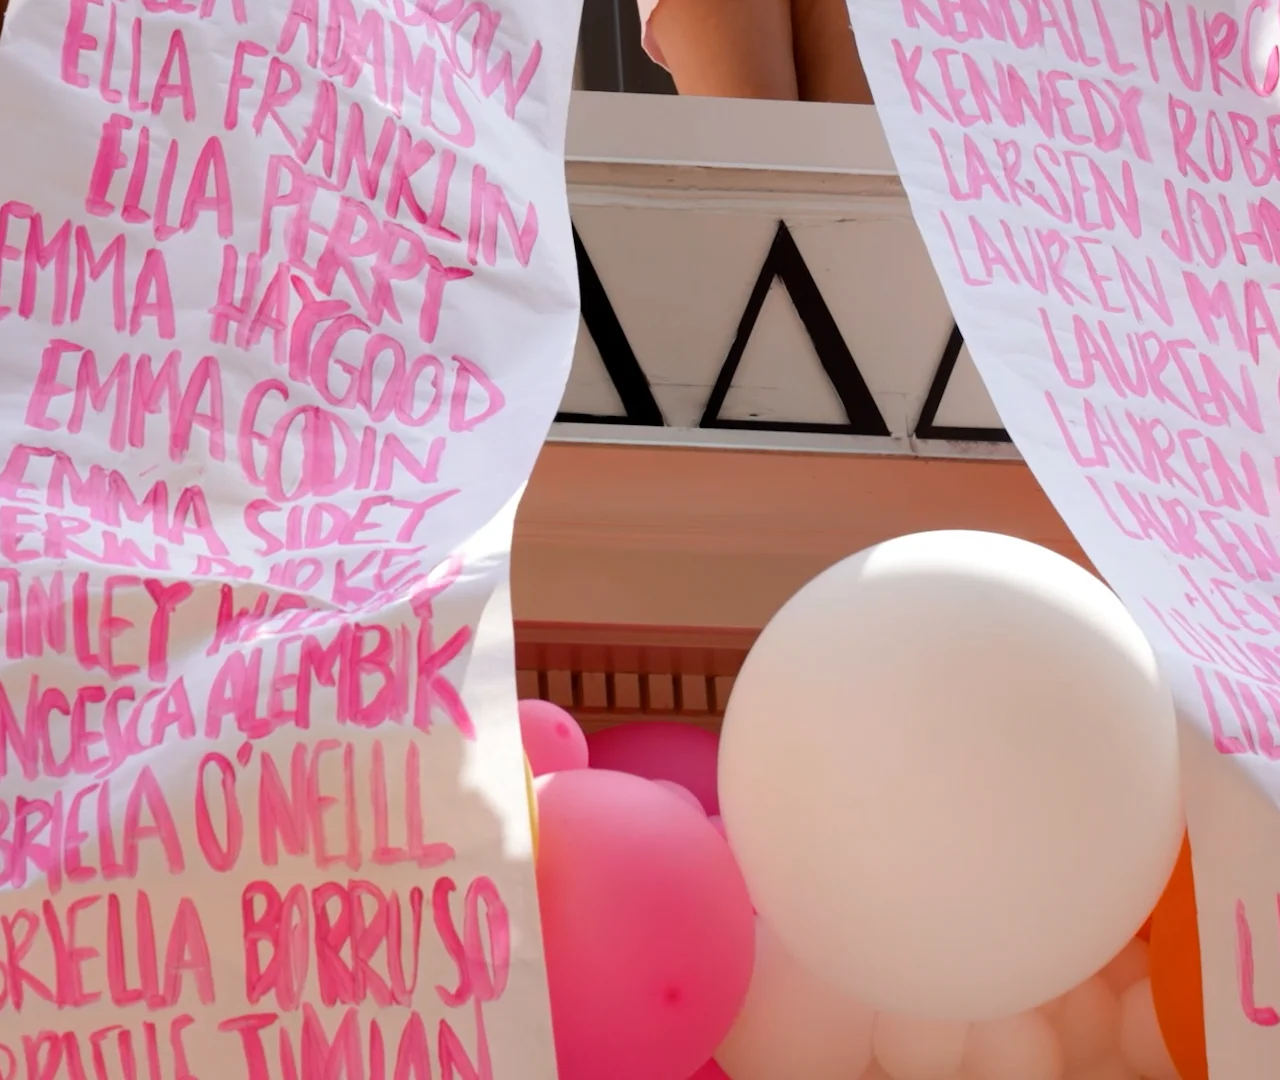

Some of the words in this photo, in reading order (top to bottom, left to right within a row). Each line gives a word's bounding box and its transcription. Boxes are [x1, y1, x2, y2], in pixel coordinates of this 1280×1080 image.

[223, 40, 539, 268] FRANKLIN
[890, 37, 1154, 163] KENNEDY
[85, 114, 234, 243] ELLA
[259, 154, 474, 344] PERRY
[929, 127, 1142, 240] LARSEN
[940, 210, 1174, 327] LAUREN
[209, 243, 506, 432] HAYGOOD
[1039, 307, 1265, 432] LAUREN
[24, 338, 226, 463] EMMA
[237, 378, 447, 503] GODIN
[1044, 389, 1270, 518] LAUREN
[203, 622, 477, 741] ALEMBIK
[241, 874, 509, 1012] BORRUSO
